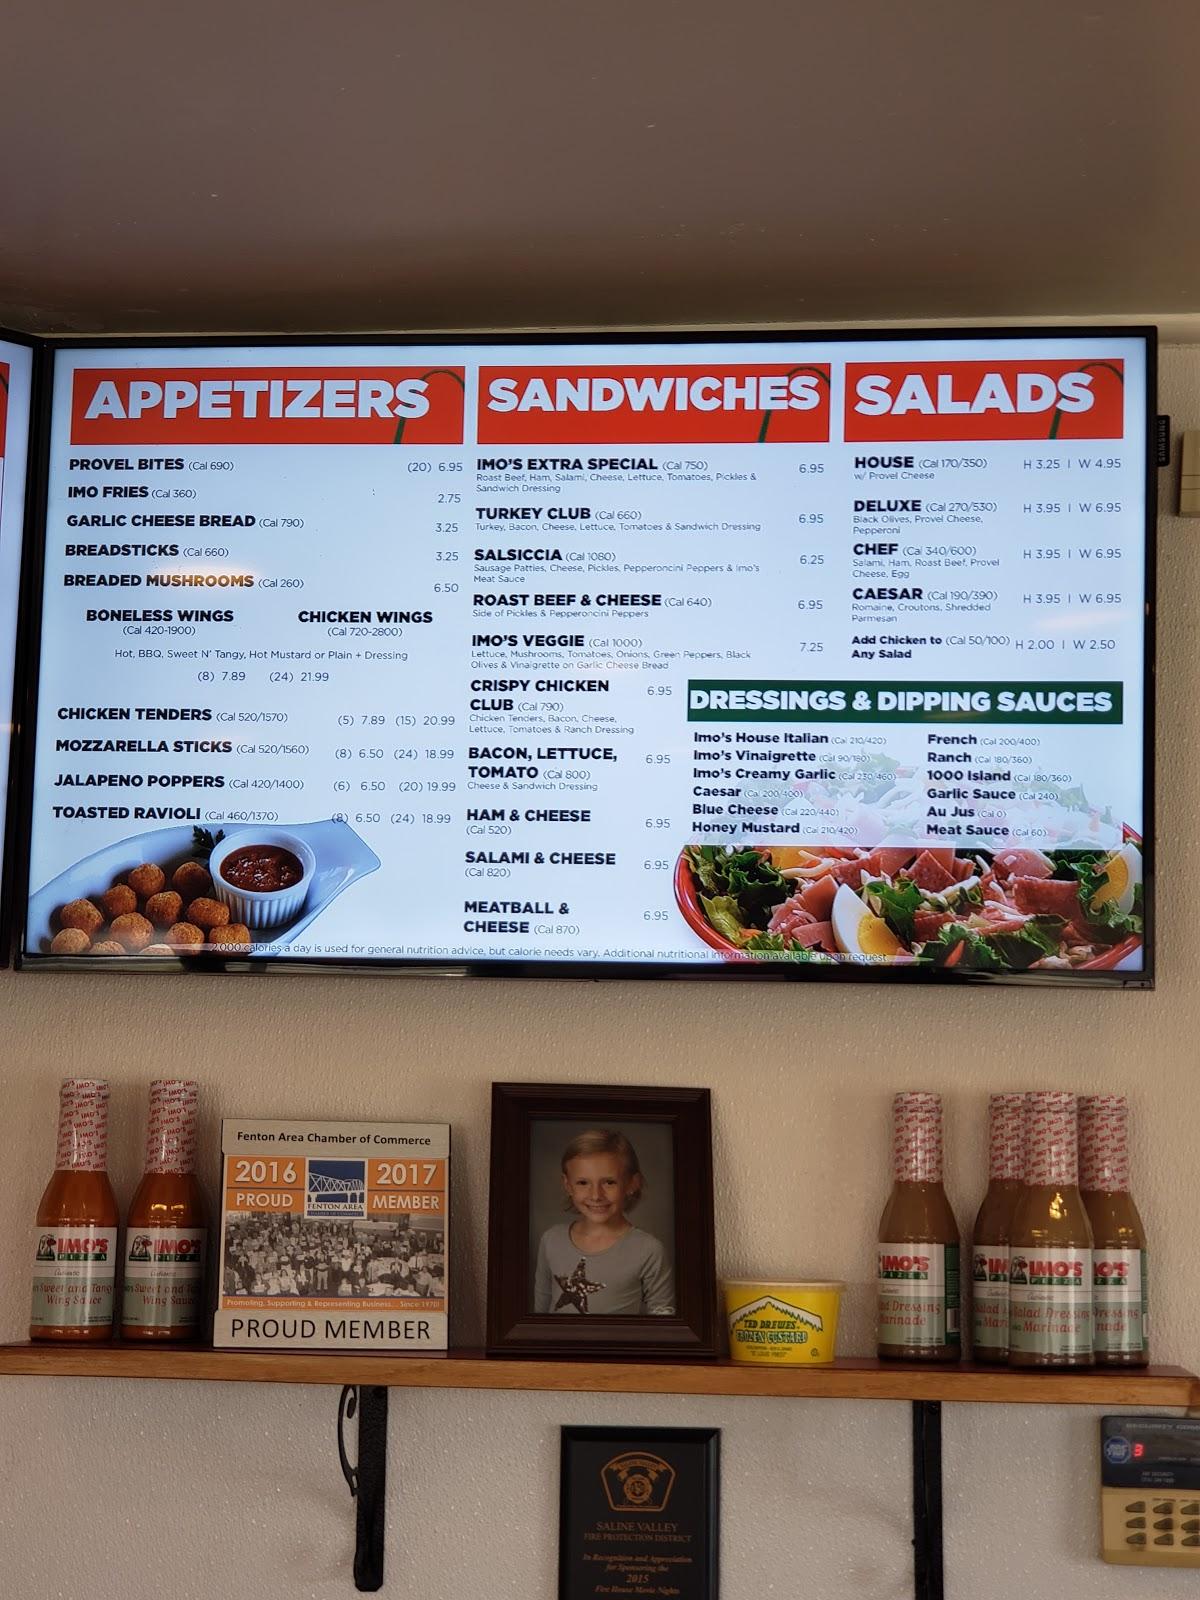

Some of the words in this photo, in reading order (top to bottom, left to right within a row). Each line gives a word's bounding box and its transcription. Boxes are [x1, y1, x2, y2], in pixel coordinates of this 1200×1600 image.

[85, 379, 429, 419] APPETIZERS
[487, 375, 820, 412] SANDWICHES
[854, 372, 1095, 416] SALADS
[1157, 419, 1167, 463] SAMSUNG
[69, 458, 134, 470] PROVEL
[138, 458, 184, 470] BITES
[189, 461, 208, 471] (Cal
[210, 461, 234, 471] 690)
[407, 462, 432, 473] (20)
[438, 462, 463, 472] 6.95
[477, 458, 523, 470] IMO'S
[527, 458, 583, 470] EXTRA
[587, 458, 658, 470] SPECIAL
[663, 461, 682, 471] (Cal
[684, 461, 708, 471] 750)
[799, 463, 824, 473] 6.95
[855, 456, 914, 469] HOUSE
[918, 459, 939, 469] (Cal
[941, 457, 988, 469] 170/350)
[68, 486, 98, 498] IMO
[102, 486, 149, 498] FRIES
[151, 489, 171, 499] (Cal
[173, 489, 197, 499] 360)
[438, 493, 461, 503] 2.75
[854, 500, 922, 512] DELUXE
[926, 502, 946, 512] (Cal
[948, 501, 997, 512] 270/530)
[475, 507, 543, 520] TURKEY
[547, 507, 591, 520] CLUB
[595, 510, 615, 520] (Cal
[617, 510, 642, 520] 660)
[799, 513, 824, 524] 6.95
[67, 515, 127, 527] GARLIC
[131, 515, 195, 527] CHEESE
[199, 515, 256, 527] BREAD
[259, 518, 278, 528] (Cal
[281, 518, 304, 529] 790)
[435, 523, 458, 533] 3.25
[721, 522, 761, 532] Dressing
[65, 544, 179, 556] BREADSTICKS
[204, 547, 229, 558] 660)
[436, 551, 459, 561] 3.25
[474, 549, 563, 561] SALSICCIA
[587, 552, 616, 562] 1080)
[853, 543, 899, 556] CHEF
[902, 546, 922, 557] (Cal
[925, 546, 977, 557] 340/600)
[800, 554, 824, 565] 6.25
[64, 574, 142, 586] BREADED
[146, 575, 254, 588] MUSHROOMS
[258, 578, 278, 589] (Cal
[280, 579, 304, 589] 260)
[434, 583, 459, 593] 6.50
[473, 594, 530, 606] ROAST
[534, 594, 576, 606] BEEF
[580, 594, 591, 606] &
[595, 594, 662, 606] CHEESE
[665, 597, 684, 607] (Cal
[686, 597, 712, 608] 640)
[852, 588, 923, 600] CAESAR
[927, 591, 948, 602] (Cal
[950, 590, 998, 601] 190/390)
[798, 600, 823, 610] 6.95
[86, 609, 173, 622] BONELESS
[177, 610, 234, 622] WINGS
[298, 610, 371, 623] CHICKEN
[376, 611, 433, 623] WINGS
[472, 635, 518, 647] IMO'S
[522, 635, 584, 647] VEGGIE
[588, 637, 609, 648] (Cal
[612, 637, 643, 649] 1000)
[800, 642, 823, 652] 7.25
[879, 635, 927, 645] Chicken
[946, 636, 966, 646] (Cal
[968, 635, 1010, 646] 50/100)
[851, 650, 875, 660] Any
[470, 680, 531, 692] CRISPY
[535, 680, 609, 692] CHICKEN
[647, 686, 672, 696] 6.95
[690, 691, 846, 711] DRESSINGS
[852, 691, 872, 711] &
[877, 691, 991, 712] DIPPING
[997, 691, 1113, 712] SAUCES
[928, 734, 977, 745] French
[56, 740, 169, 752] MOZZARELLA
[173, 740, 232, 753] STICKS
[237, 744, 256, 754] (Cal
[258, 744, 309, 755] 520/1560)
[54, 774, 143, 787] JALAPENO
[147, 775, 225, 788] POPPERS
[229, 779, 249, 789] (Cal
[251, 779, 304, 790] 420/1400)
[52, 806, 130, 819] TOASTED
[134, 807, 201, 820] RAVIOLI
[205, 811, 225, 821] (Cal
[227, 811, 279, 822] 460/1370)
[467, 809, 505, 821] HAM
[509, 809, 520, 822] &
[525, 809, 591, 822] CHEESE
[927, 824, 962, 835] Meat
[966, 825, 1010, 836] Sauce
[1031, 827, 1047, 837] 60)
[465, 851, 529, 864] SALAMI
[534, 852, 545, 864] &
[549, 852, 616, 865] CHEESE
[237, 1131, 275, 1141] Fenton
[278, 1132, 304, 1142] Area
[307, 1133, 357, 1144] Chamber
[373, 1135, 431, 1146] Commerce
[235, 1160, 296, 1183] 2016
[377, 1163, 436, 1184] 2017
[236, 1193, 293, 1207] PROUD
[372, 1195, 439, 1209] MEMBER
[308, 1203, 339, 1211] FENTON
[342, 1203, 364, 1211] AREA
[57, 1238, 109, 1254] IMO'S
[882, 1256, 930, 1272] IMO'S
[1029, 1261, 1083, 1277] IMO'S
[232, 1319, 316, 1338] PROUD
[325, 1320, 430, 1339] MEMBER
[744, 1319, 758, 1329] TED
[596, 1521, 635, 1532] SALINE
[638, 1522, 679, 1533] VALLEY
[603, 1533, 653, 1542] PROTECTION
[655, 1534, 691, 1543] DISTRICT
[626, 1574, 649, 1584] 2015
